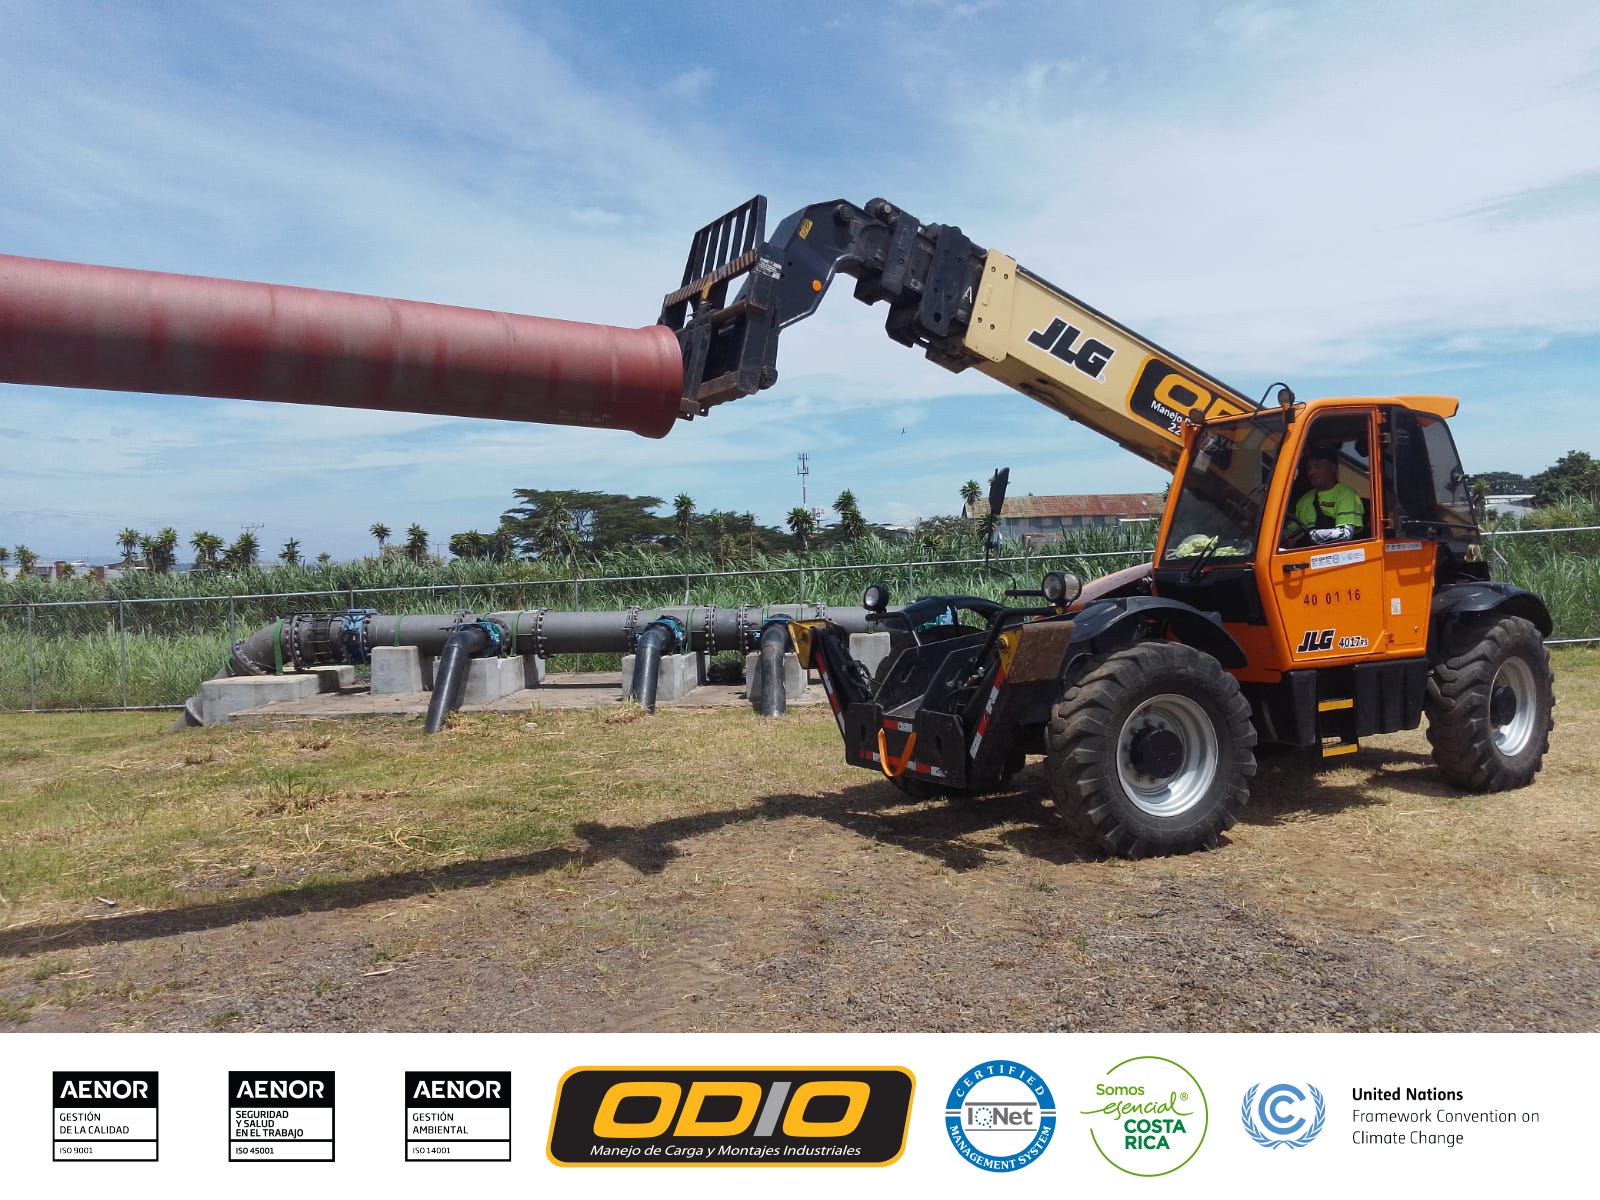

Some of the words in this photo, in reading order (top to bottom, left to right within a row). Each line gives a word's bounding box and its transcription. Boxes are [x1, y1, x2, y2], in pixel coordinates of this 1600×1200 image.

[1027, 317, 1115, 379] JLG
[1150, 400, 1183, 423] Manejo
[1297, 629, 1335, 653] JLG
